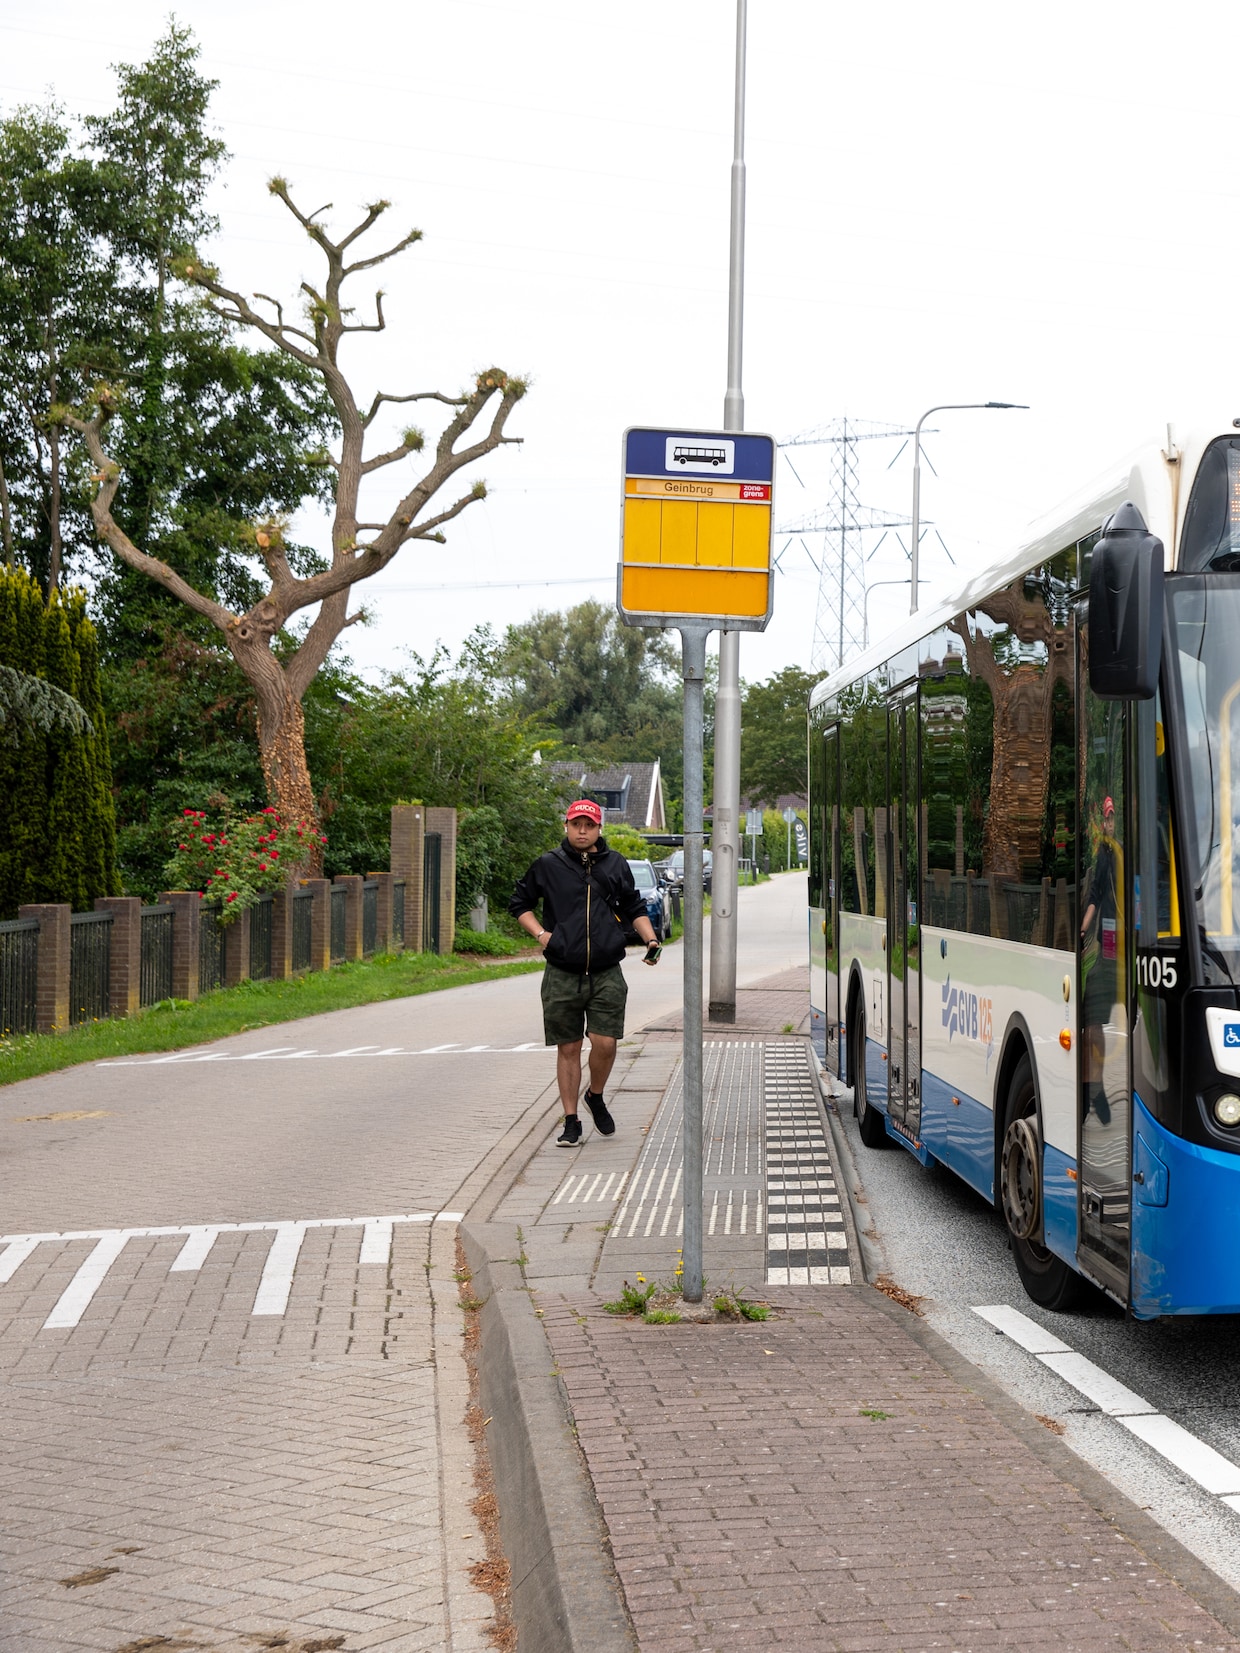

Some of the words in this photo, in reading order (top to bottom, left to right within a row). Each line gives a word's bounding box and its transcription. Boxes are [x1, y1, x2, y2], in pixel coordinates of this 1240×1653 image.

[664, 482, 714, 496] Geinbrug
[743, 490, 764, 498] grens
[574, 804, 596, 813] GUCCI
[1135, 955, 1178, 988] 1105
[958, 990, 978, 1040] GVB
[979, 996, 994, 1045] 125
